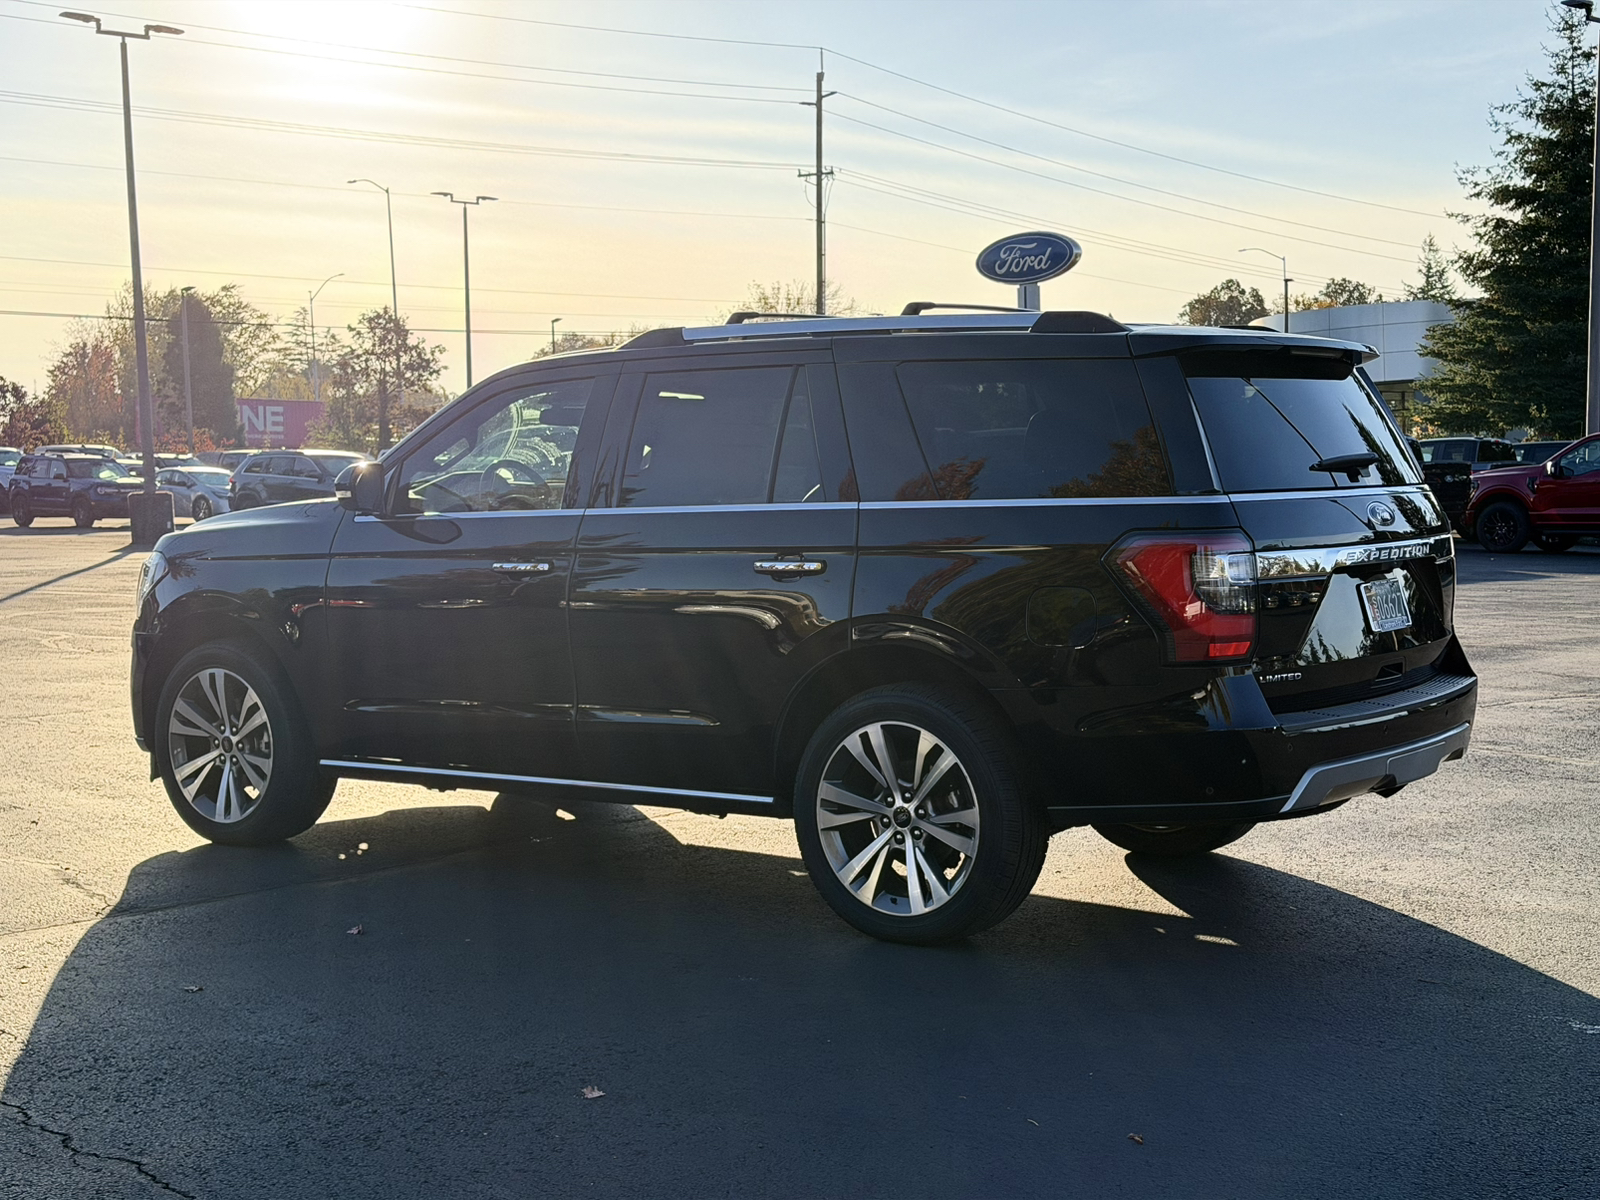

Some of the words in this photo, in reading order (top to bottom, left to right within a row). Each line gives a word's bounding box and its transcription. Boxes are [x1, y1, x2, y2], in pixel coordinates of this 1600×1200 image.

[995, 242, 1052, 274] Ford
[1347, 544, 1430, 561] EXPEDITION
[1259, 672, 1302, 683] LIMITED
